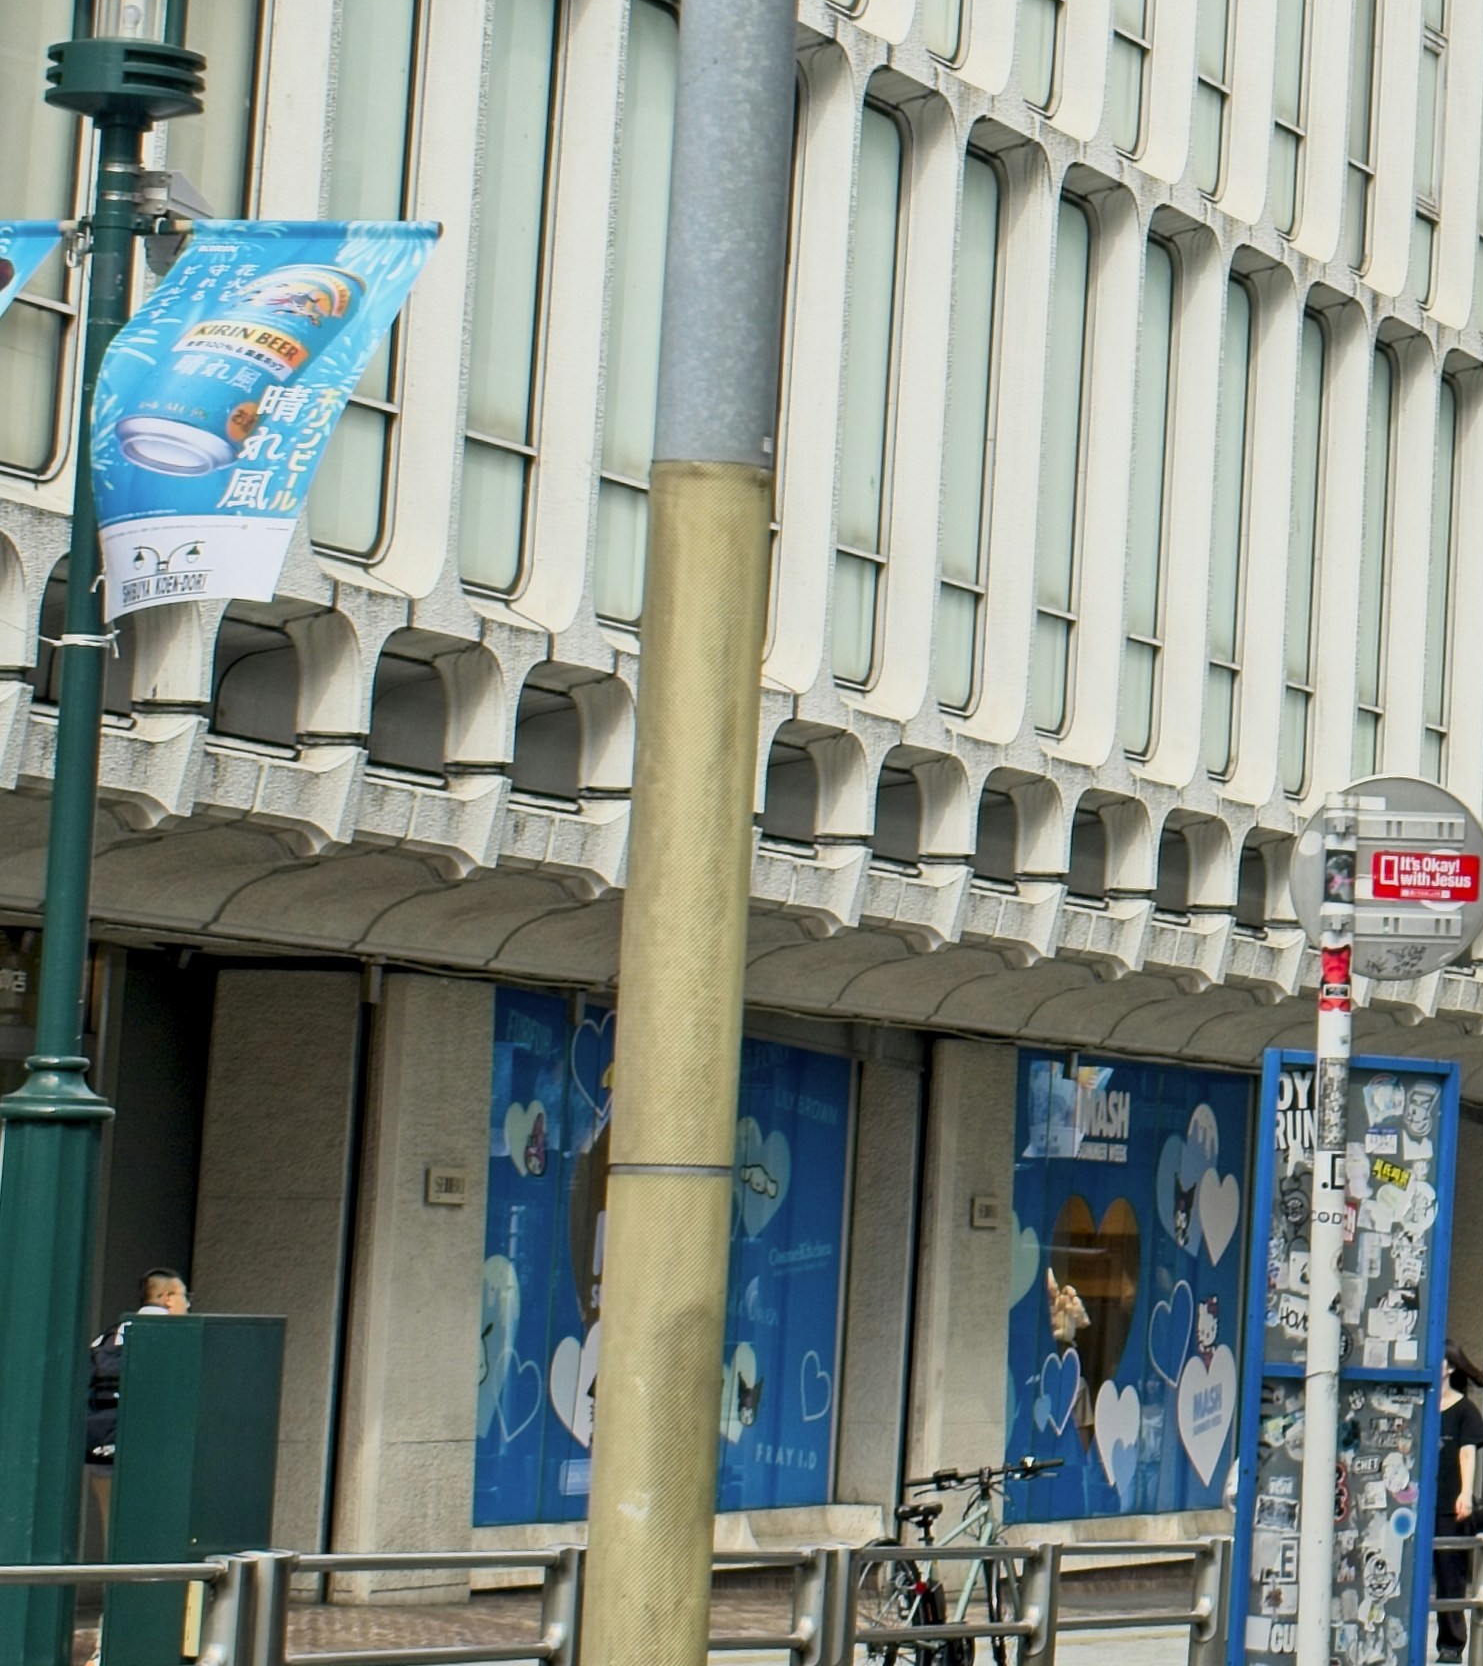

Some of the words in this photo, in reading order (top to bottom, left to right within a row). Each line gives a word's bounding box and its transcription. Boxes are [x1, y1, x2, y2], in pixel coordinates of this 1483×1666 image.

[194, 323, 257, 341] KIRIN
[255, 331, 298, 364] BEER
[173, 354, 262, 394] 晴れ風
[215, 383, 313, 512] 晴れ風
[269, 386, 346, 513] キリンビール
[121, 577, 151, 604] SHIBUYA
[154, 571, 209, 596] KOEN-DORI
[1400, 856, 1420, 872] It's
[1422, 856, 1461, 874] Okay!
[1400, 871, 1431, 887] with
[1431, 872, 1473, 889] Jesus
[1276, 1110, 1318, 1150] RUN
[755, 1442, 795, 1467] FRAY
